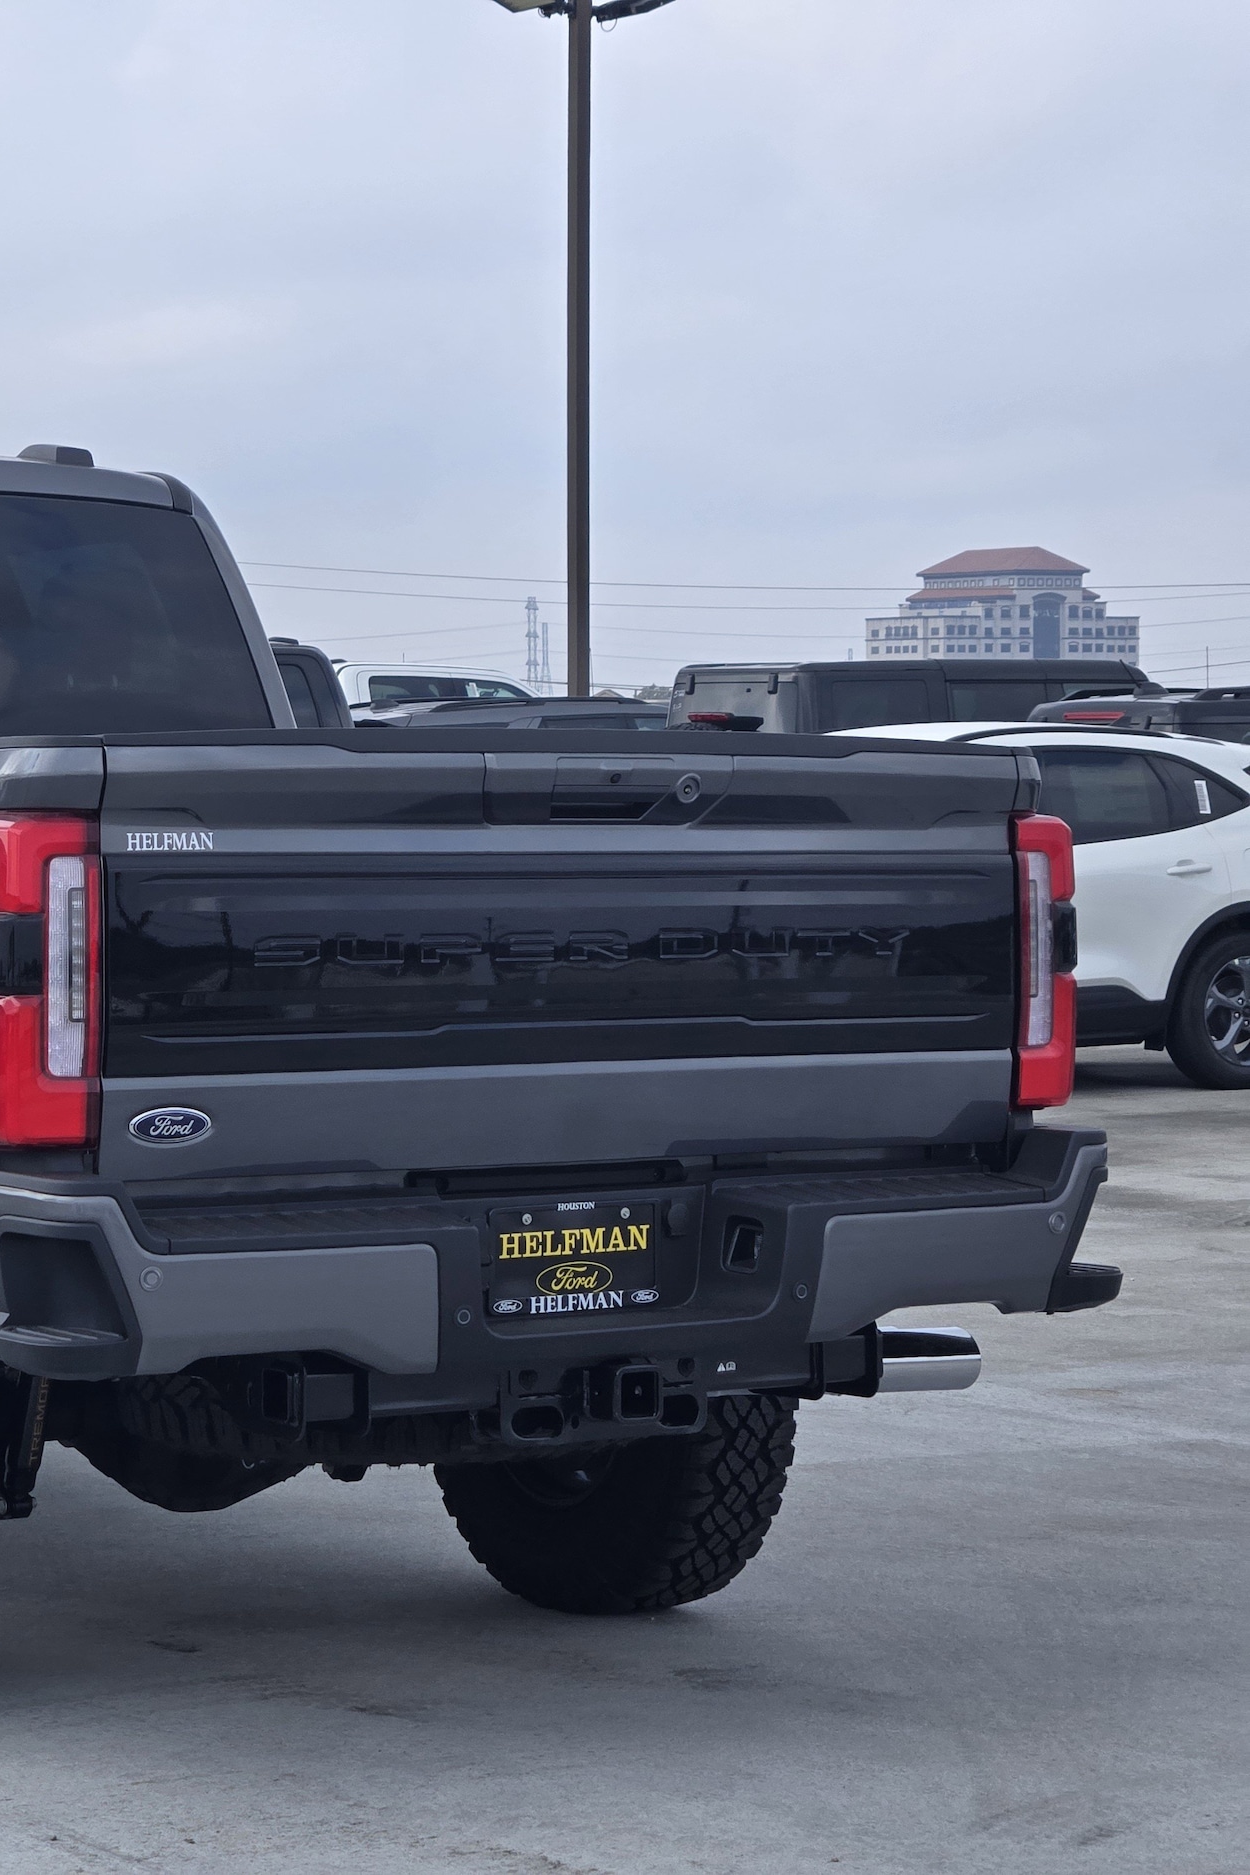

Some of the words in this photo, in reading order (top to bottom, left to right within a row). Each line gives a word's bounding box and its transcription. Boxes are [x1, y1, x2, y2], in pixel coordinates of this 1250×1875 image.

[126, 832, 214, 851] HELFMAN
[254, 931, 629, 966] SUPER
[659, 927, 910, 959] DUTY
[149, 1115, 194, 1136] Ford
[557, 1202, 595, 1212] HOUSTON
[499, 1225, 650, 1260] HELFMAN
[551, 1266, 598, 1291] Ford
[498, 1301, 517, 1311] Ford
[530, 1291, 623, 1314] HELFMAN
[636, 1291, 654, 1301] Ford
